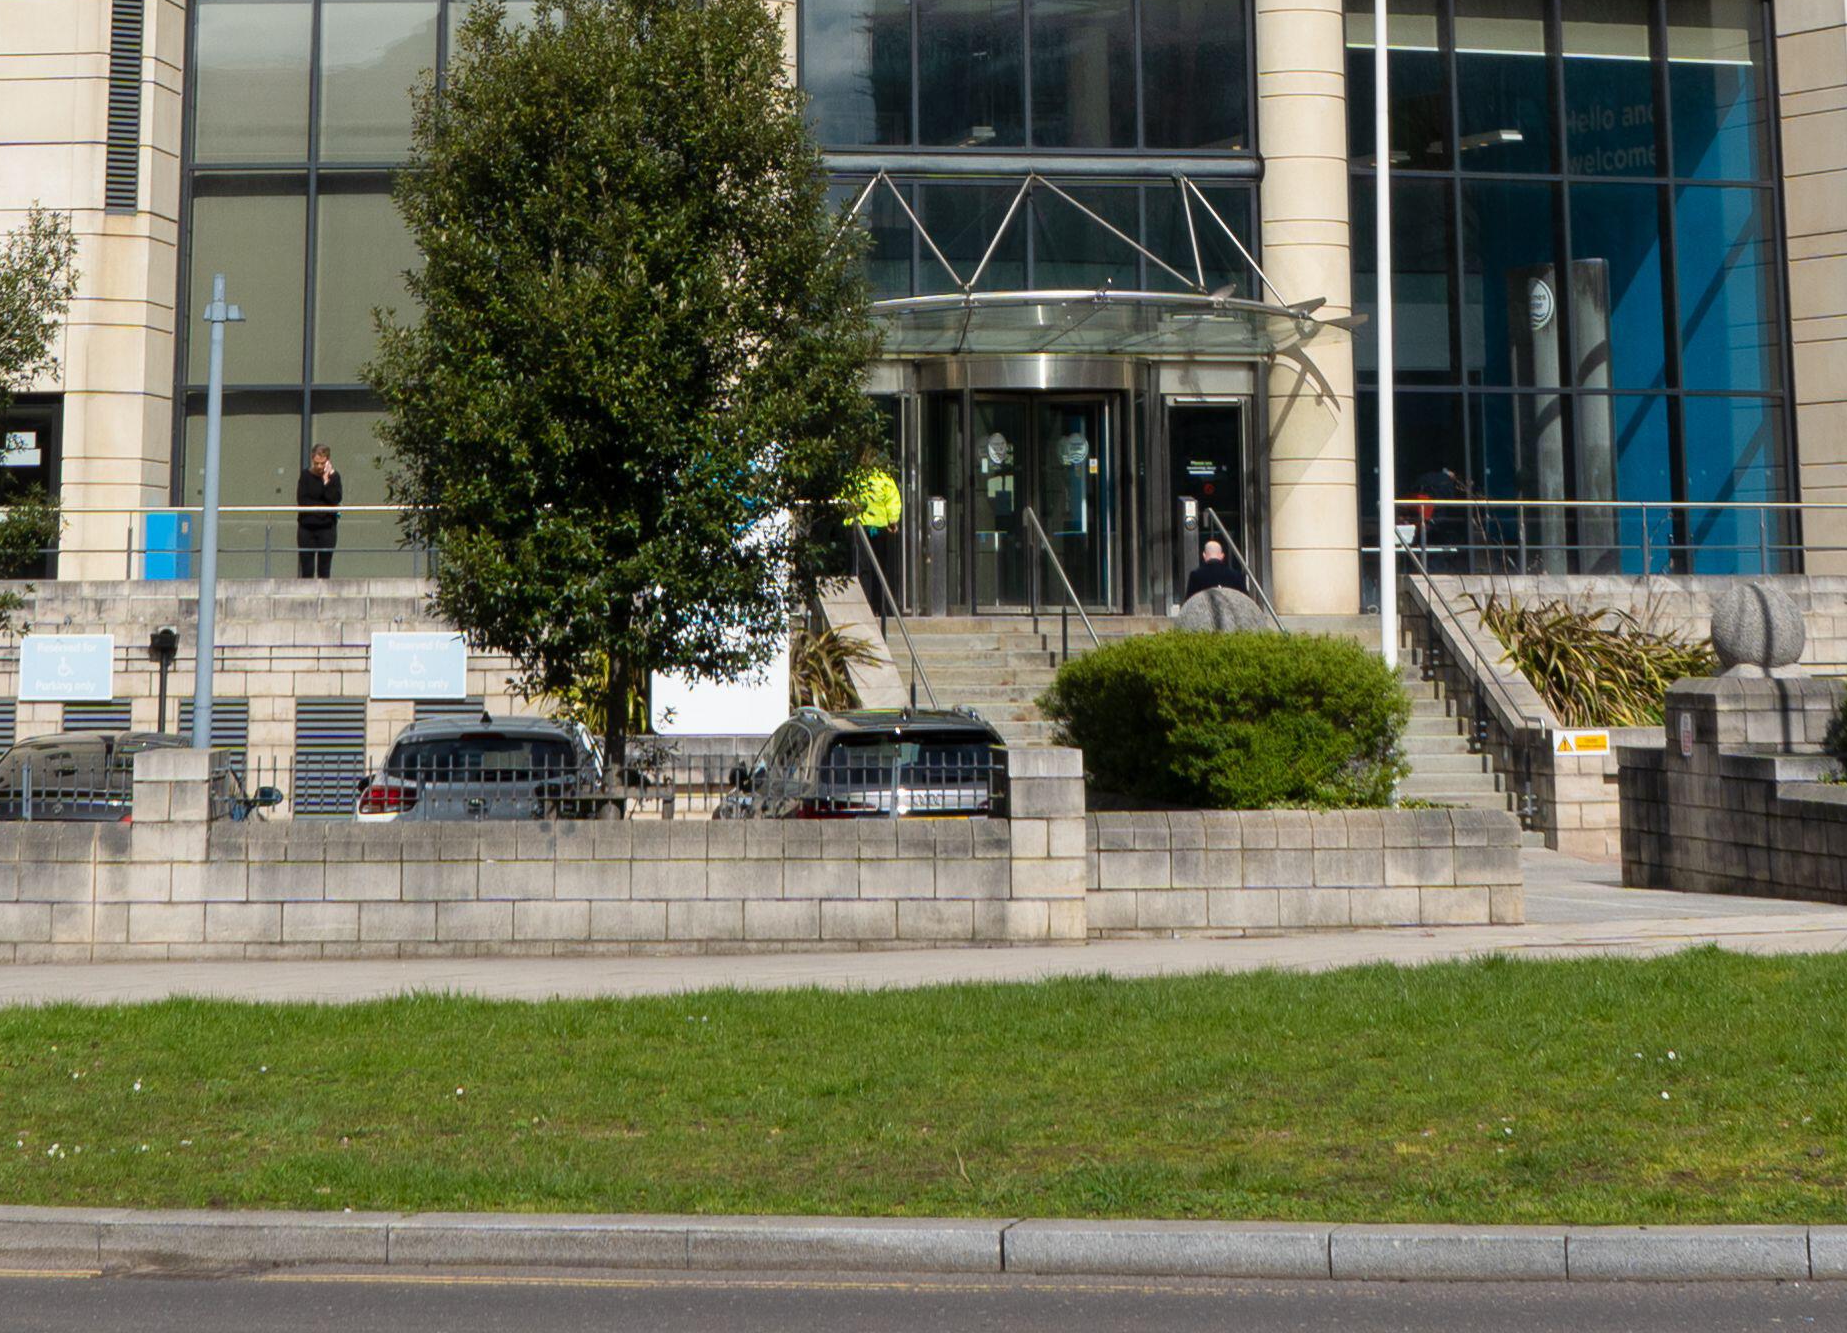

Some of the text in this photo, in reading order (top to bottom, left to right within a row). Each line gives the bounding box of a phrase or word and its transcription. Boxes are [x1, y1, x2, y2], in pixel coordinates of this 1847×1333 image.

[1566, 144, 1657, 174] welcome
[37, 642, 98, 653] Reserved for
[35, 679, 97, 693] Parking only
[387, 678, 449, 692] Parking only
